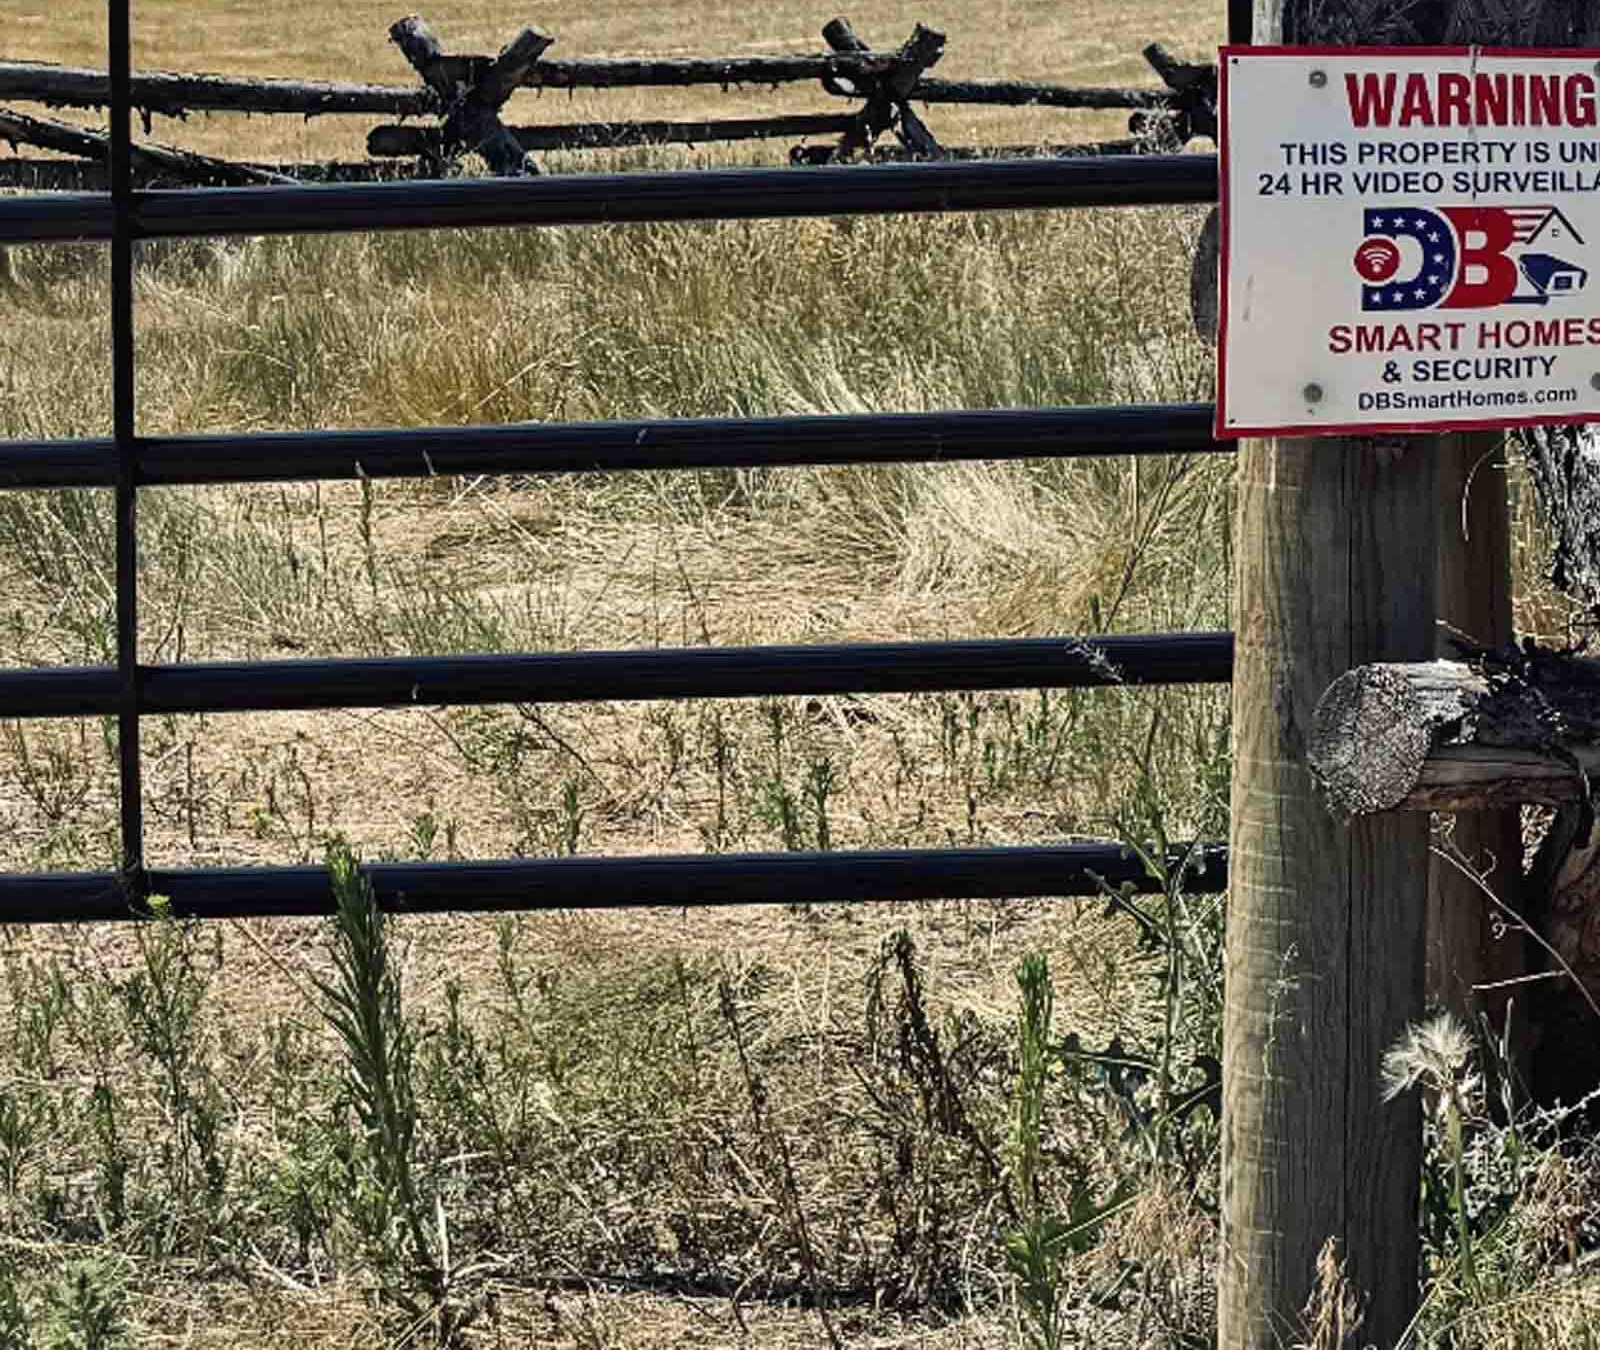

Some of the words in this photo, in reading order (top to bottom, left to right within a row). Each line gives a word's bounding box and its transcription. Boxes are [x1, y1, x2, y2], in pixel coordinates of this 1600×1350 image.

[1344, 72, 1598, 128] WARNING
[1280, 143, 1347, 166] THIS
[1357, 141, 1518, 165] PROPERTY
[1525, 141, 1551, 164] IS
[1258, 173, 1292, 196] 24
[1301, 172, 1344, 195] HR
[1352, 171, 1444, 195] VIDEO
[1328, 321, 1467, 354] SMART
[1381, 360, 1403, 384] &
[1411, 355, 1559, 383] SECURITY
[1358, 386, 1578, 412] DBSmartHomes.com
